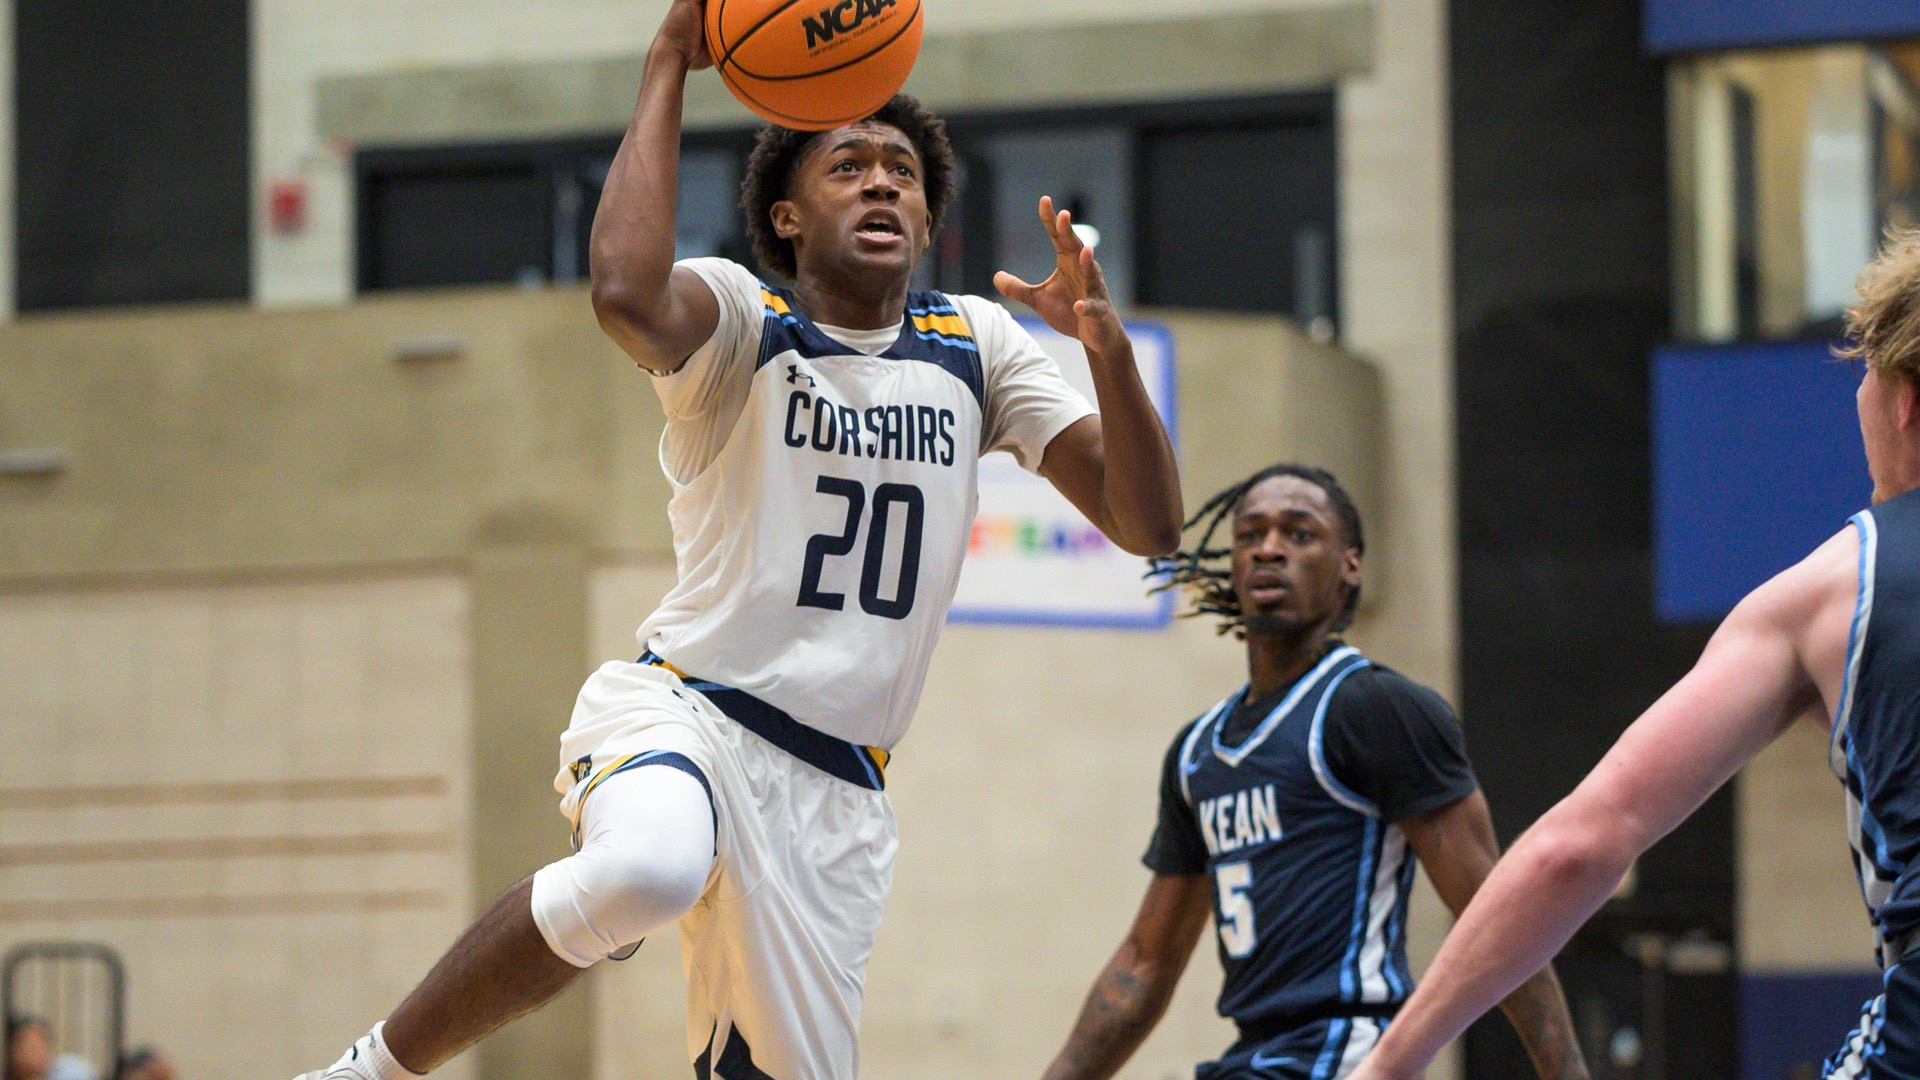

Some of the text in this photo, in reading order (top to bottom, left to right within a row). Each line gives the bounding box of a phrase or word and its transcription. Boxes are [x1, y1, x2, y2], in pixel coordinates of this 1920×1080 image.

[785, 390, 955, 467] CORSAIRS
[796, 475, 925, 620] 20
[1200, 784, 1283, 857] KEAN
[1214, 859, 1257, 958] 5
